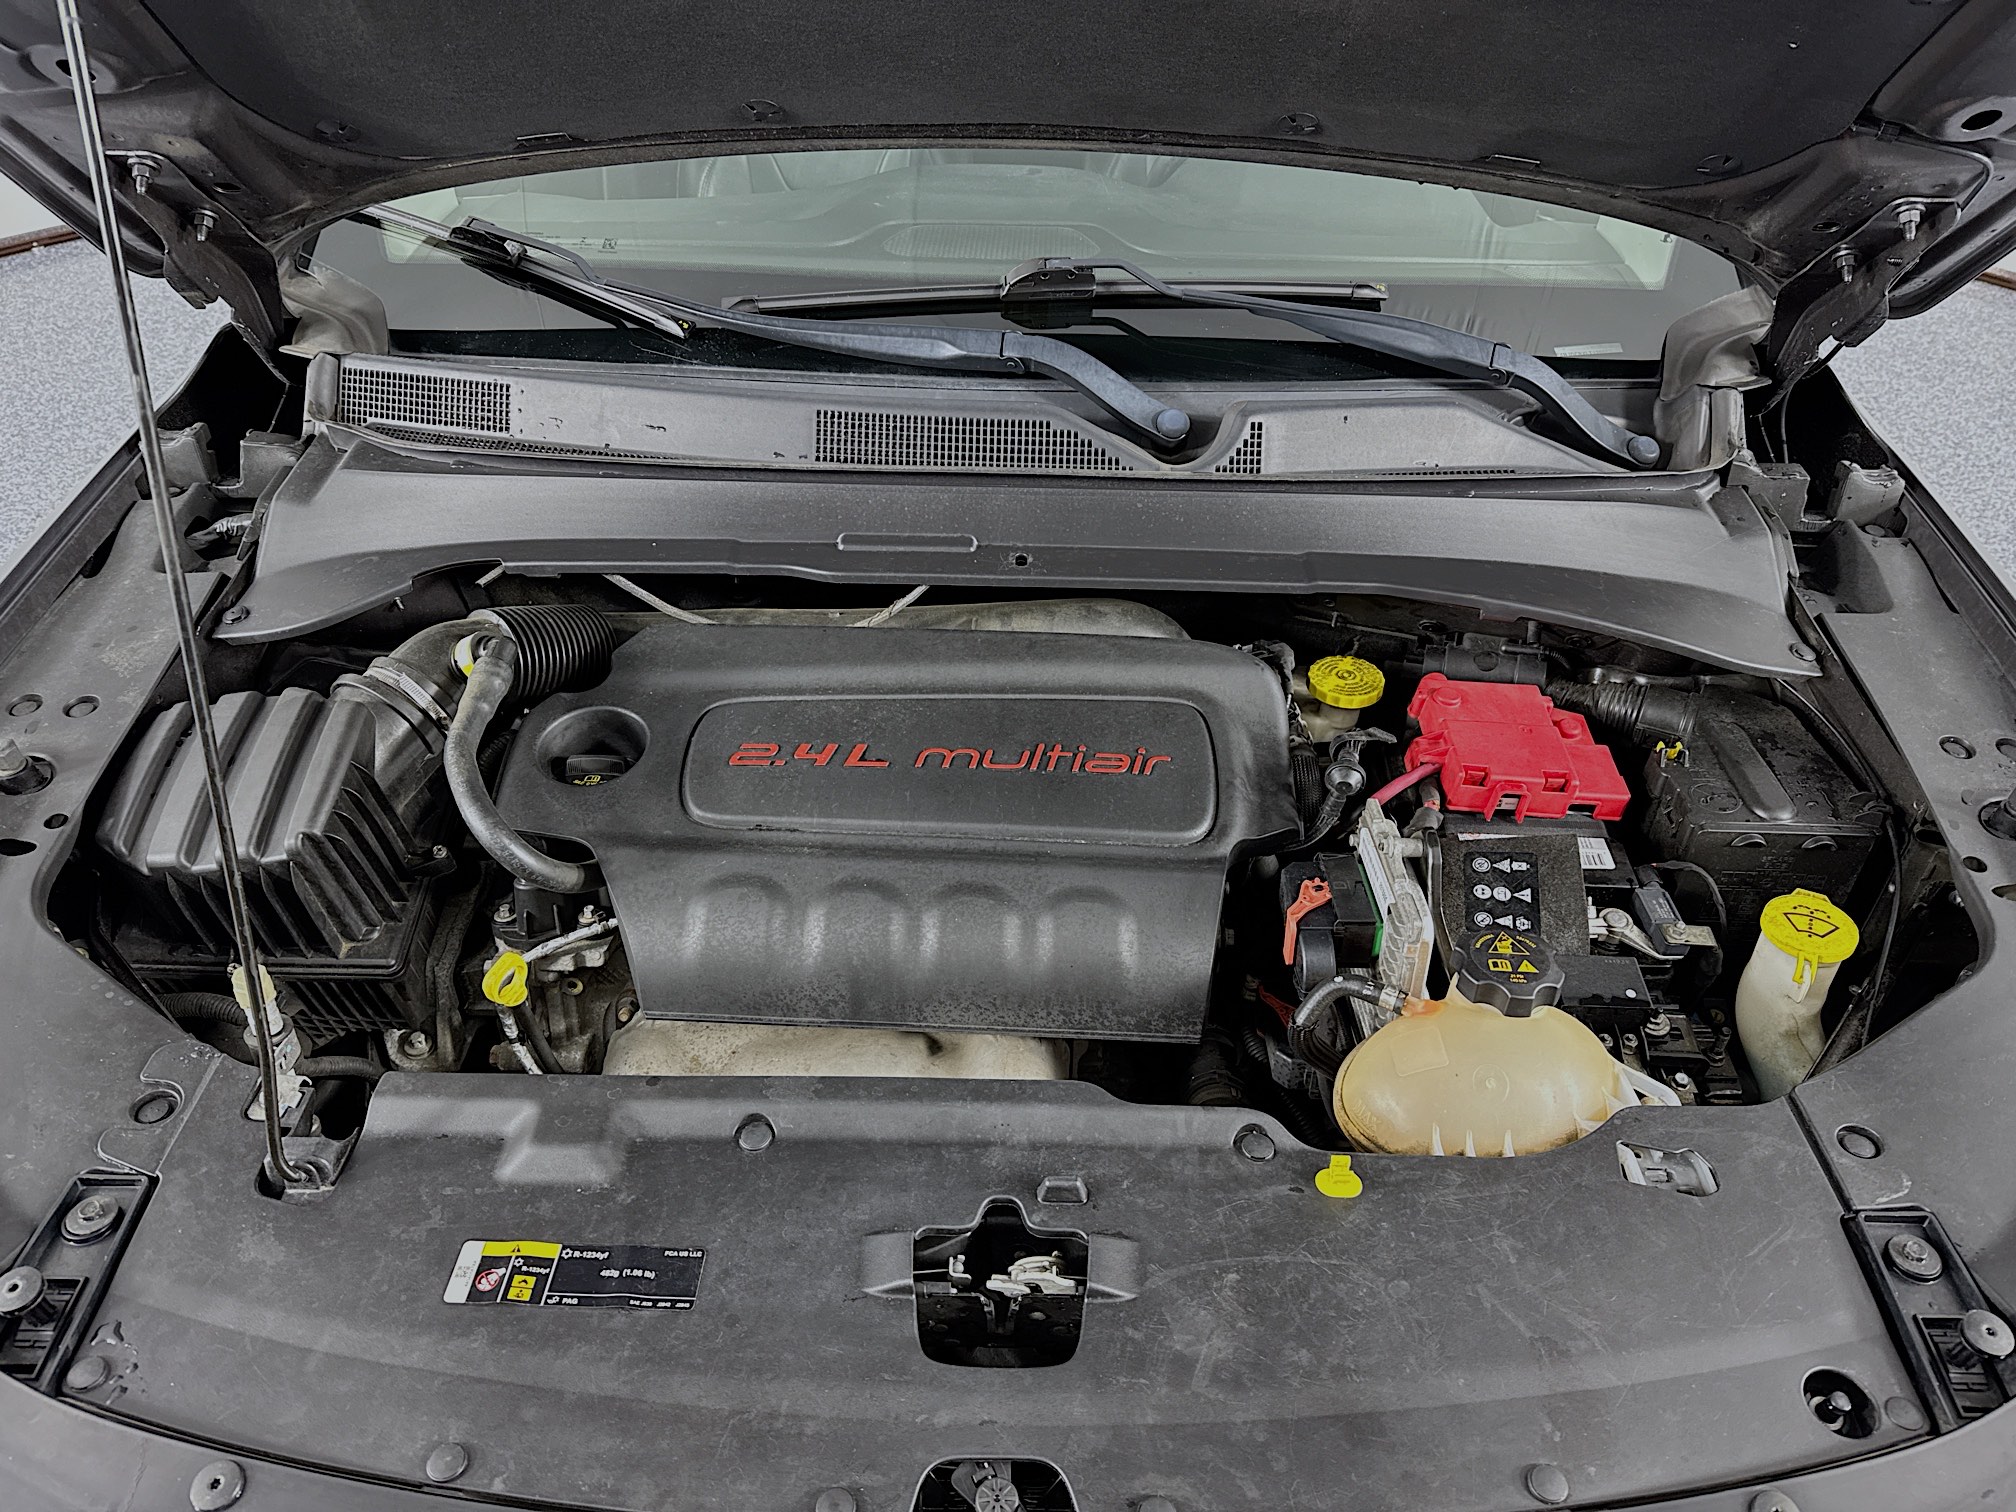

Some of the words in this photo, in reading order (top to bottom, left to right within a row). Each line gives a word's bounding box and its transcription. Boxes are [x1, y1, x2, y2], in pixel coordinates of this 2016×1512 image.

[914, 743, 1172, 776] multiair
[572, 1250, 610, 1261] R-1234yf
[689, 1250, 703, 1258] LLC
[521, 1265, 551, 1275] R-1234yf
[561, 1297, 579, 1305] PAG
